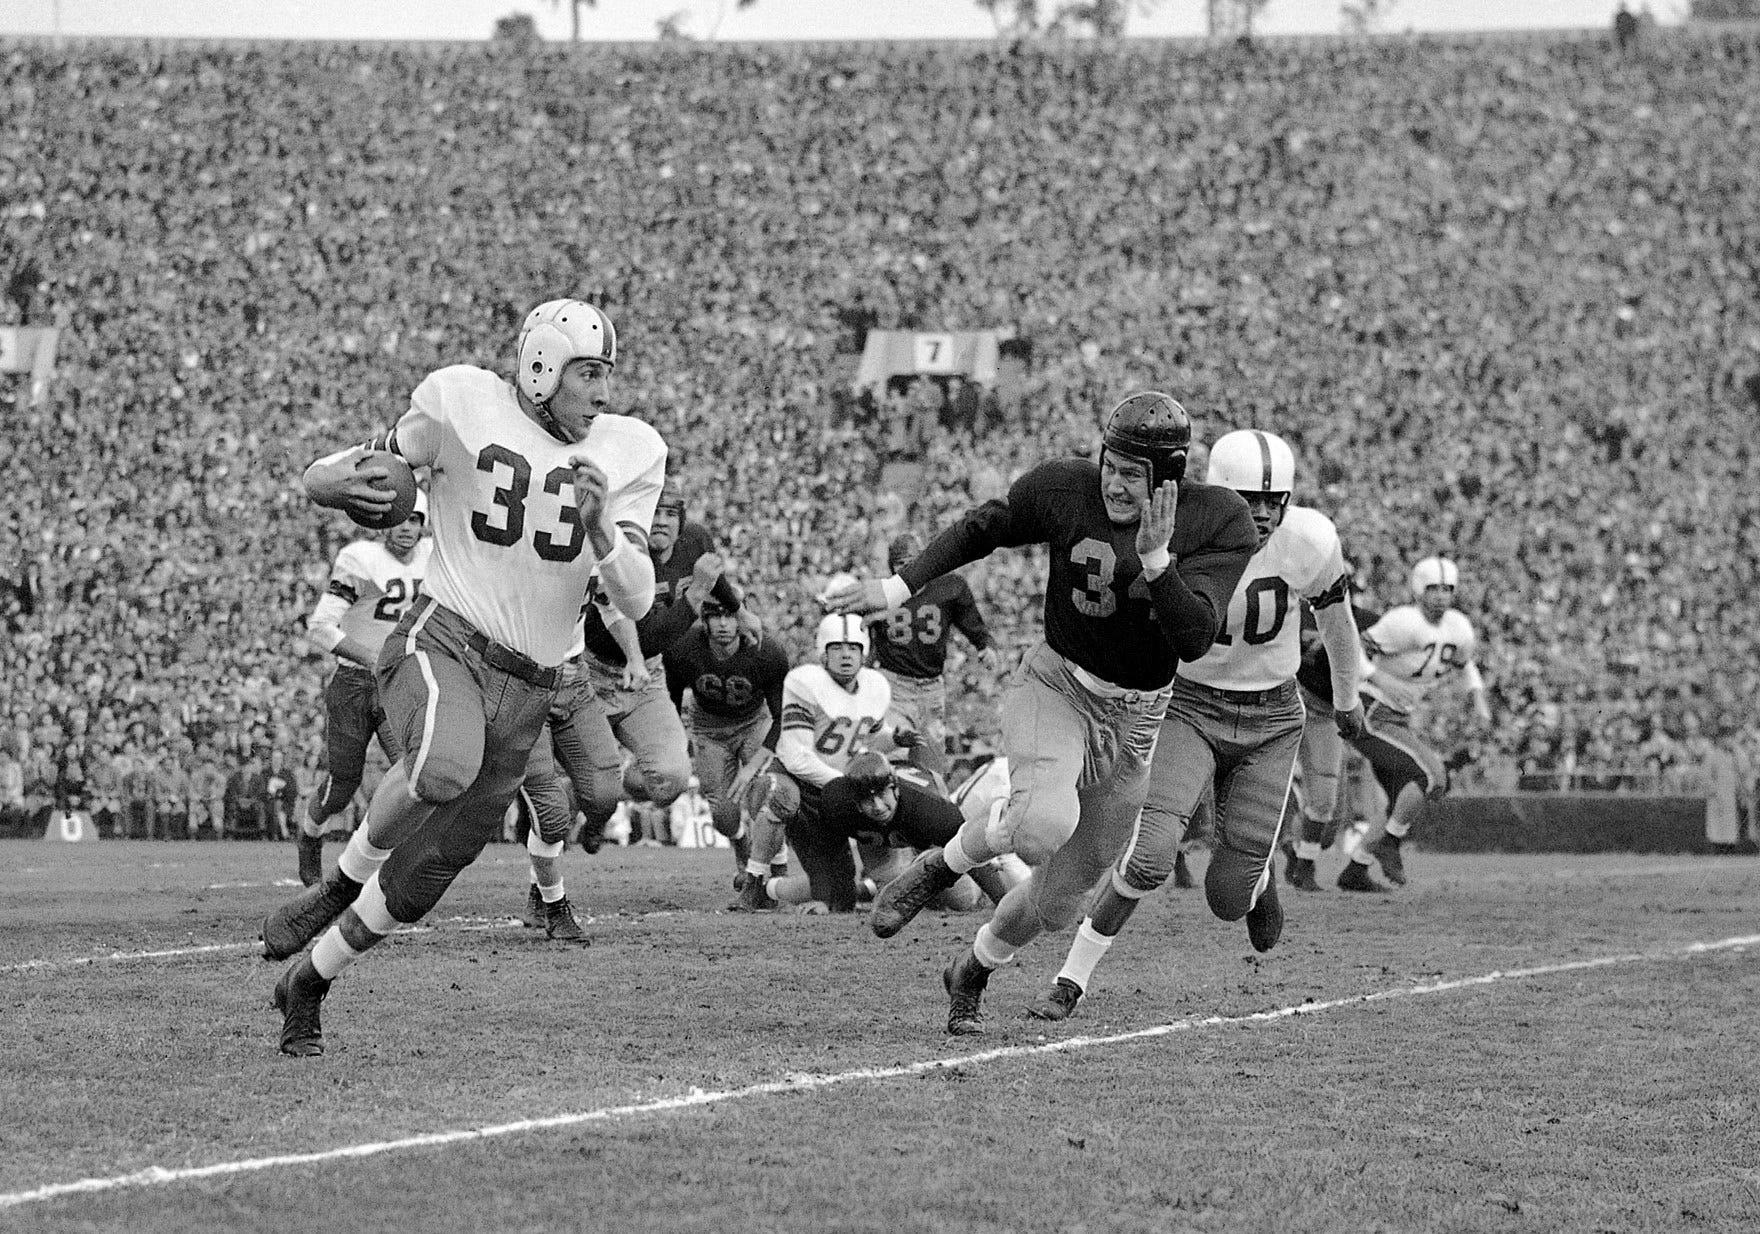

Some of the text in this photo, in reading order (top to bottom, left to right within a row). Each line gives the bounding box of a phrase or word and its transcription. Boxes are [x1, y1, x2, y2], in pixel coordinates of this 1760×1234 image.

[926, 341, 941, 362] 7
[471, 443, 587, 563] 33
[887, 604, 942, 645] 83
